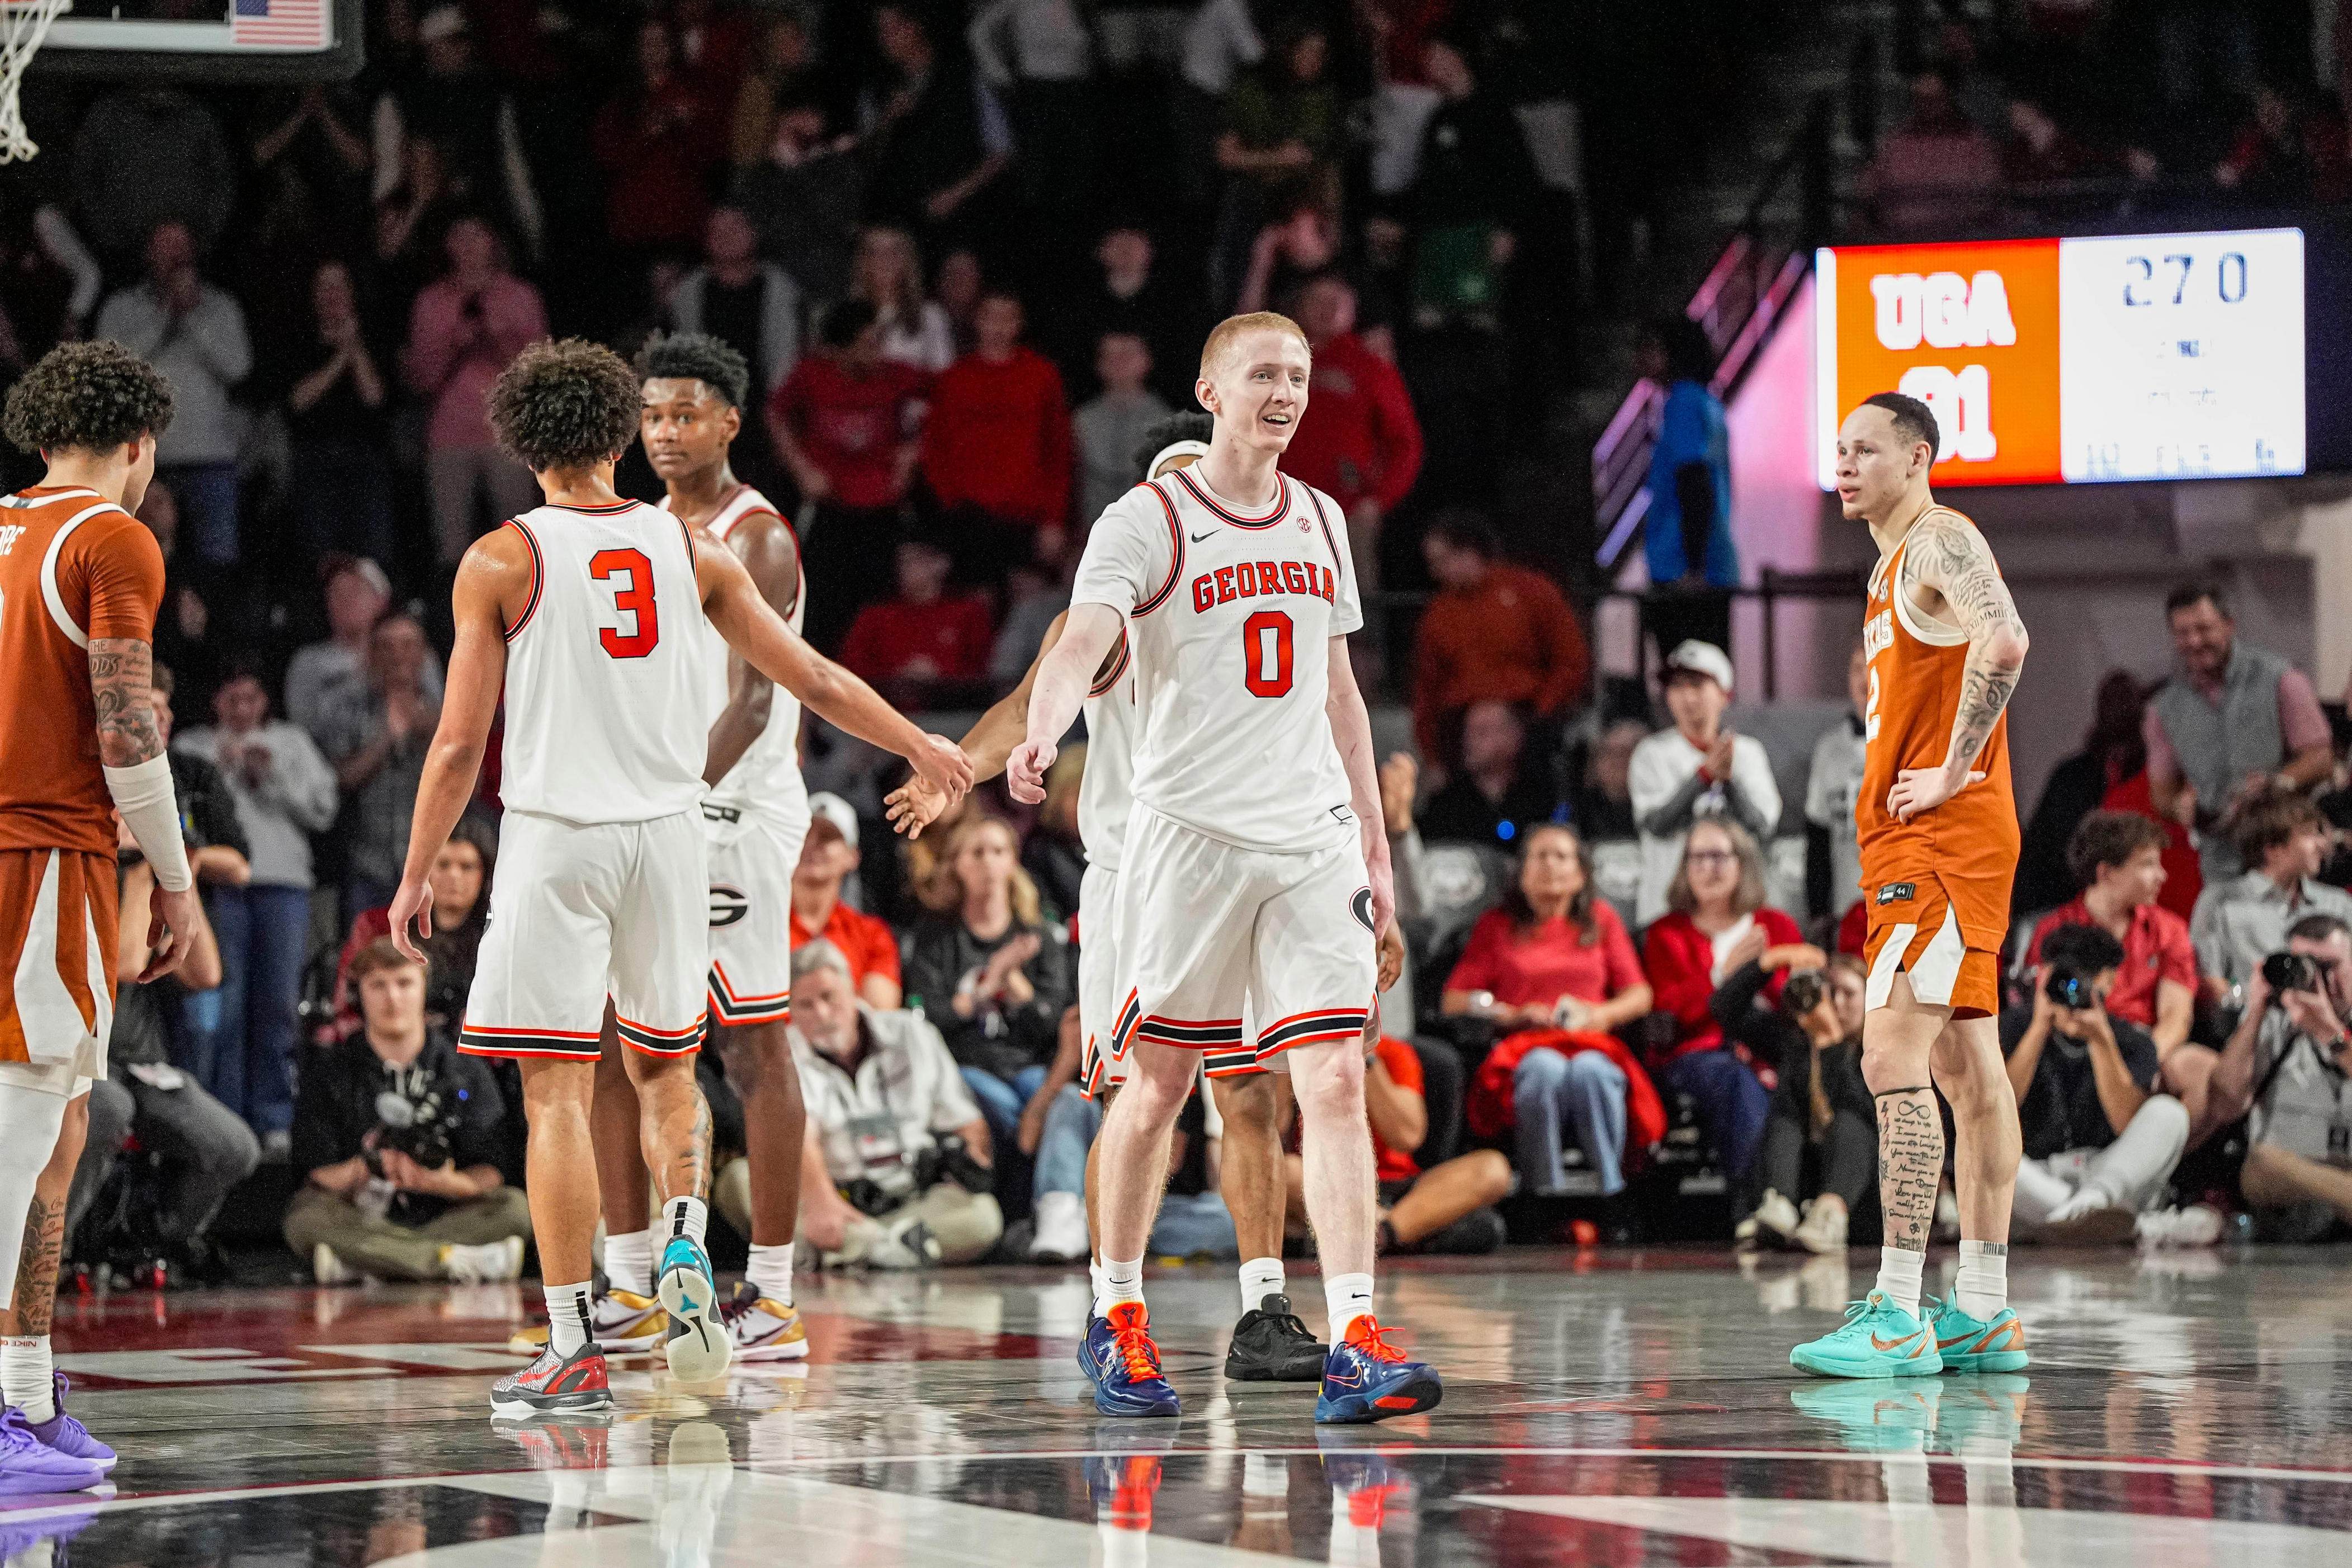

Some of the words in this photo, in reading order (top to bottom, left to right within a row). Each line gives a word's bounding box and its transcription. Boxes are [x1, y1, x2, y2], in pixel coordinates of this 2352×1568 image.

[1869, 270, 2016, 350] UGA
[1297, 517, 1310, 532] SEC
[589, 547, 659, 659] 3
[1192, 561, 1335, 614] GEORGIA
[1243, 611, 1293, 698] 0
[1863, 608, 1895, 665] EXAS
[1865, 665, 1881, 744] 2
[709, 885, 749, 928] G
